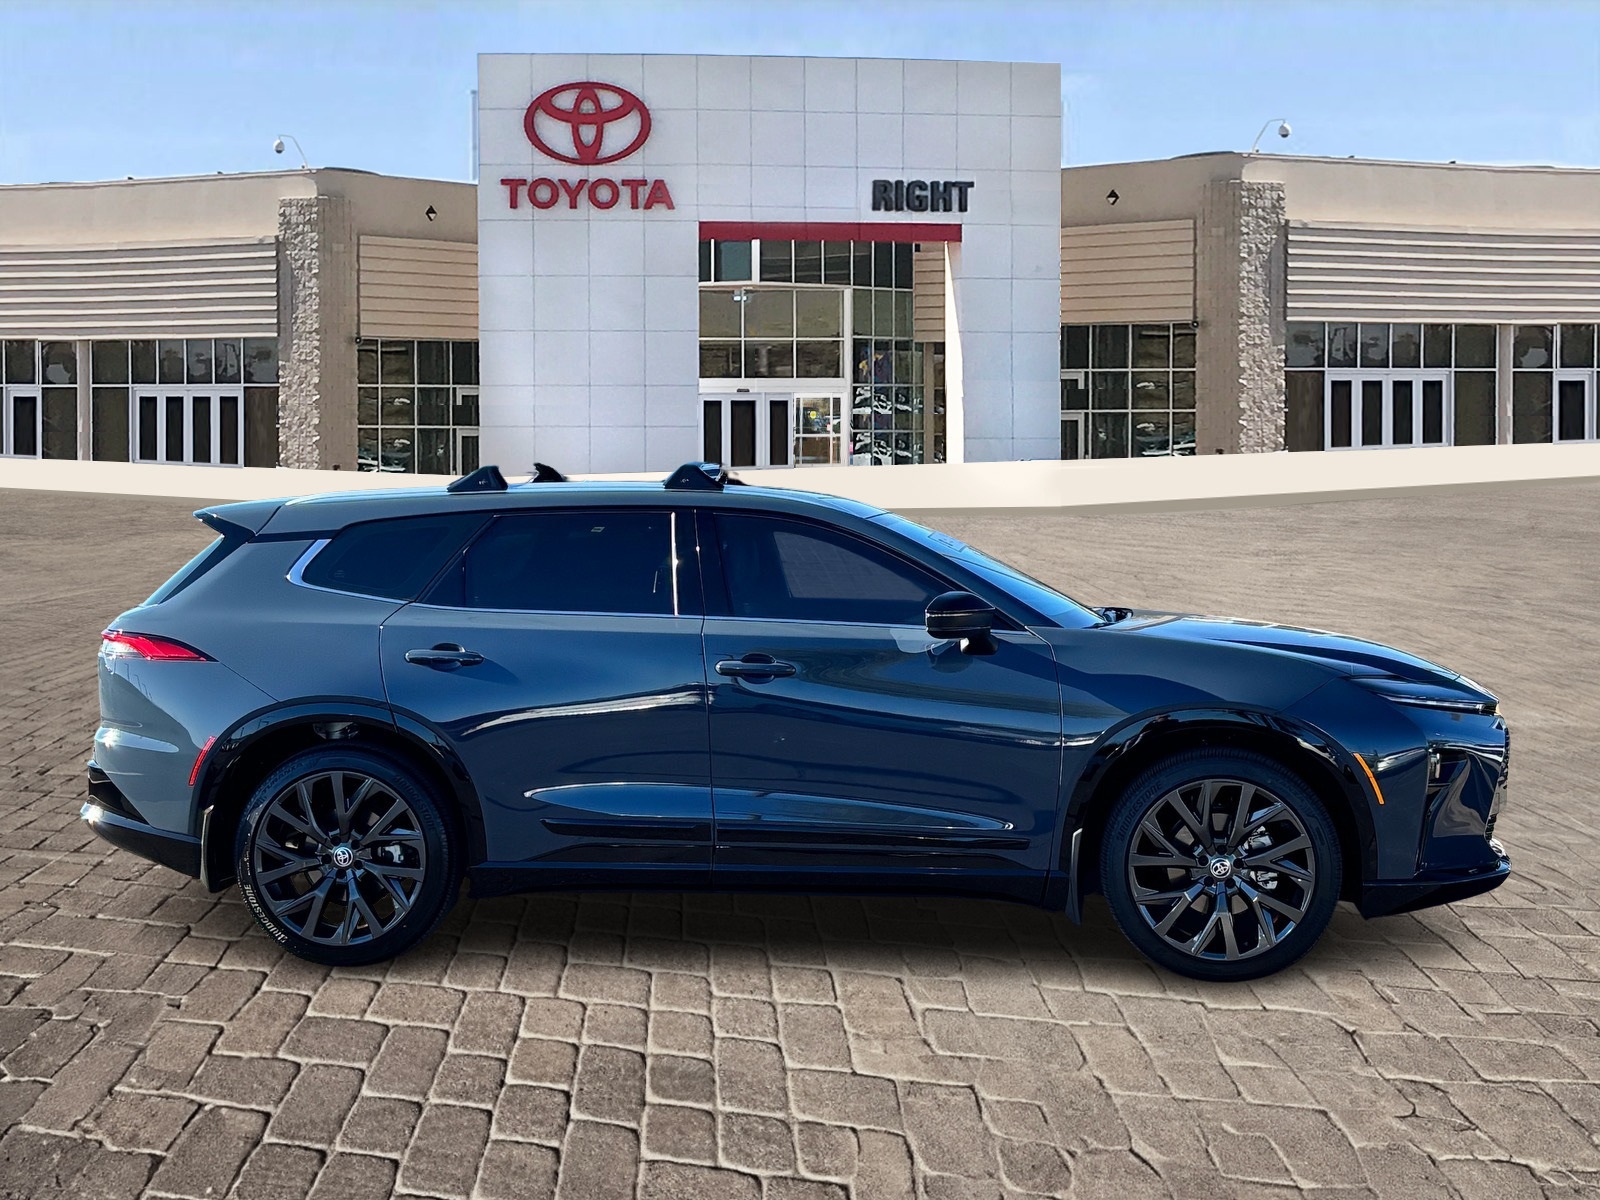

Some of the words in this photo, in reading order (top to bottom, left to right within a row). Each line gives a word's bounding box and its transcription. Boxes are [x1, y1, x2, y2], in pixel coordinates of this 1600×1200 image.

[500, 178, 675, 210] TOYOTA
[872, 180, 975, 212] RIGHT
[1116, 780, 1162, 842] BRIDGESTONE
[244, 884, 289, 943] BRIDGESTONE
